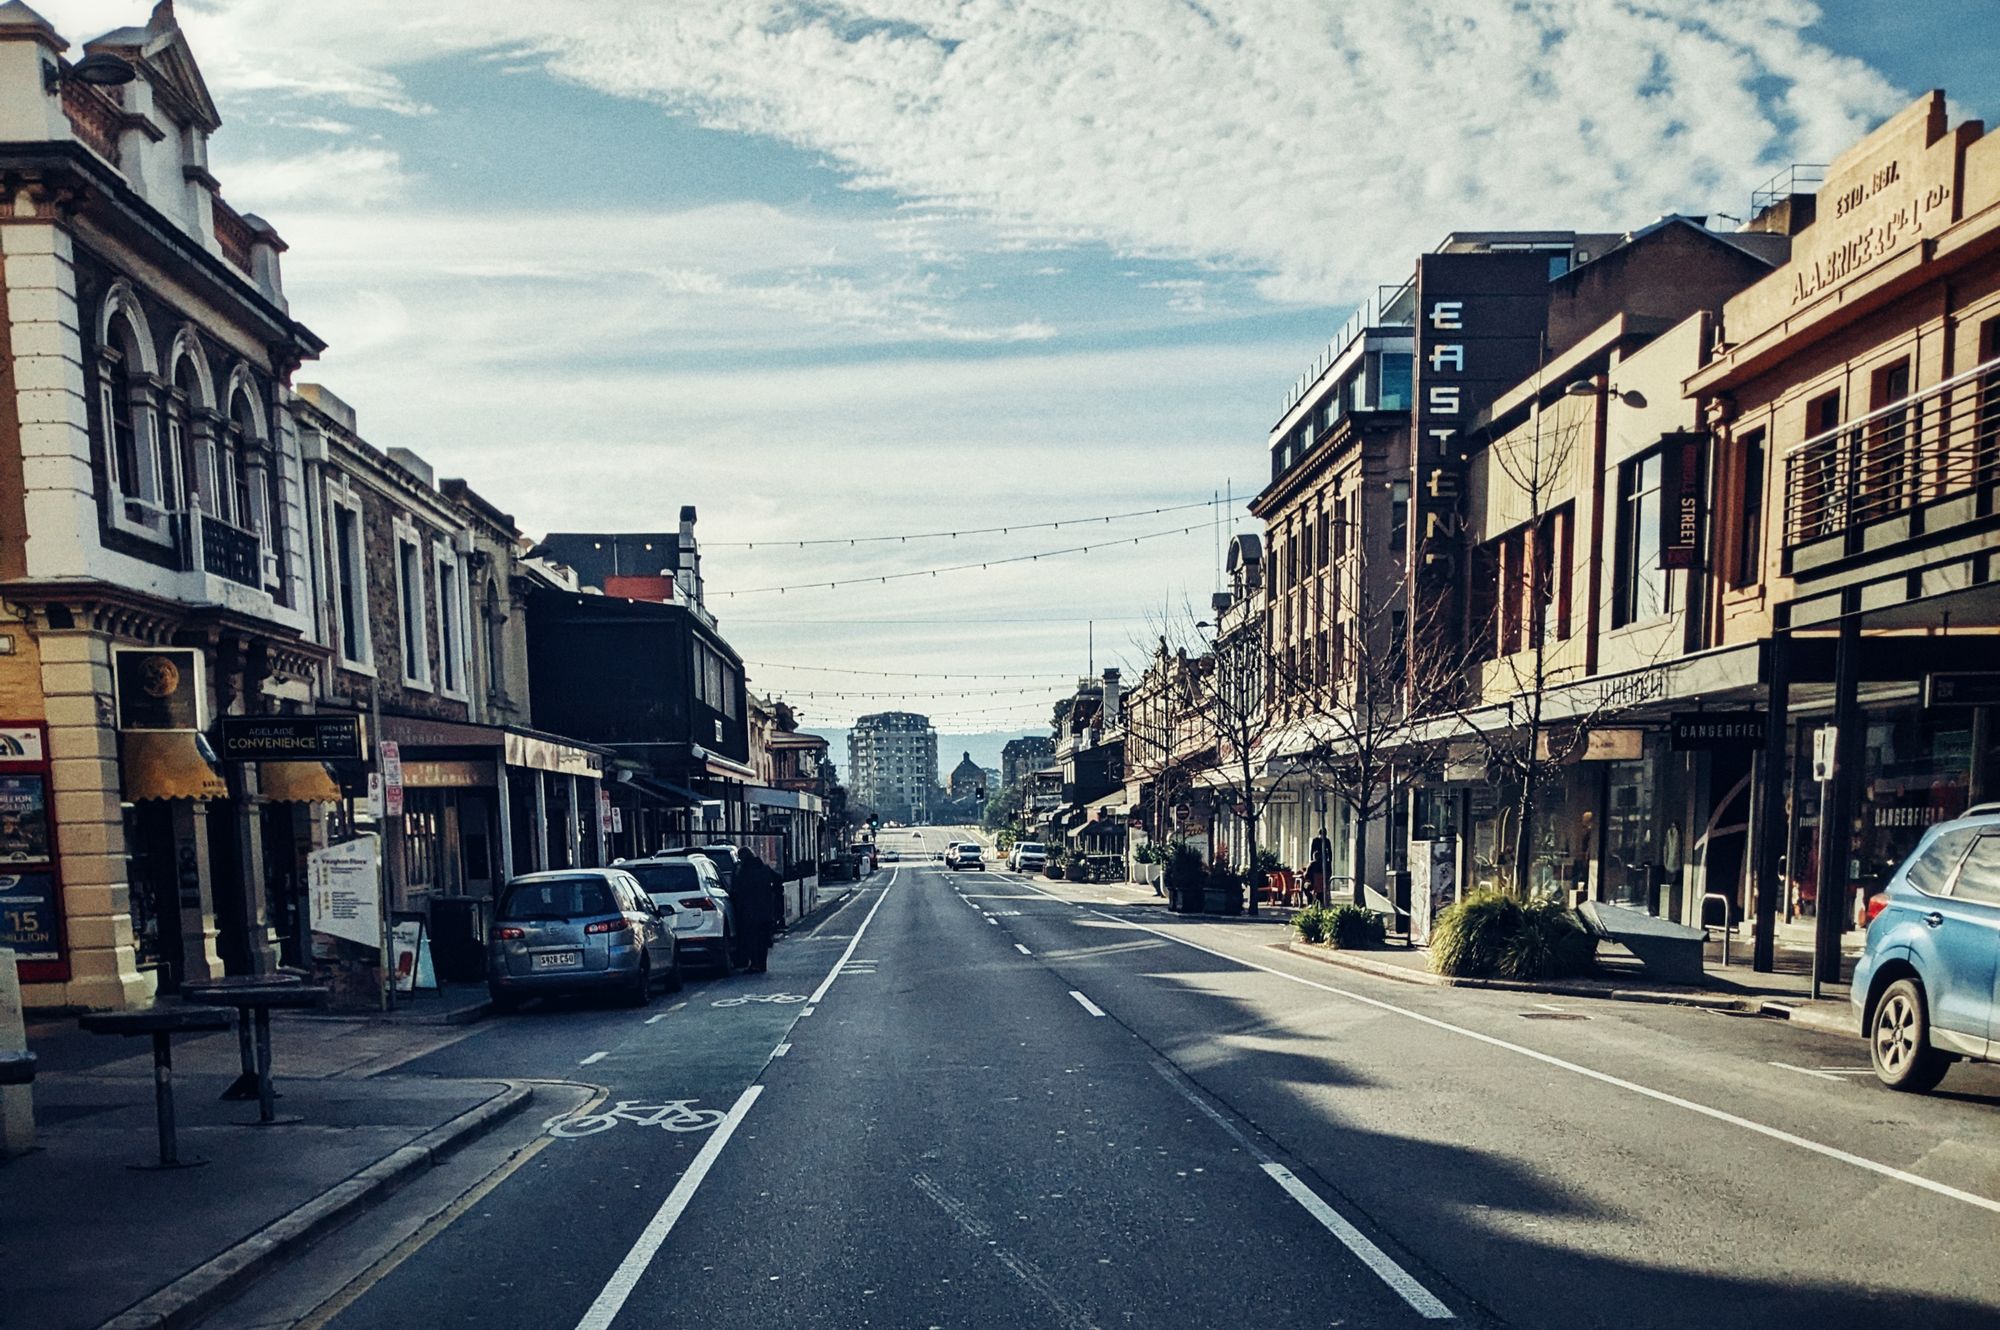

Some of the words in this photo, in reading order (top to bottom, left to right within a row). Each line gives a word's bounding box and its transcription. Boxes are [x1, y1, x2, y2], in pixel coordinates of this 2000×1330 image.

[1680, 497, 1696, 545] STREET
[248, 727, 295, 736] ADELAIDE
[1680, 723, 1764, 738] DANGERFIEL
[228, 737, 316, 749] CONVENIENCE
[1874, 806, 1945, 827] DANGERFIELD
